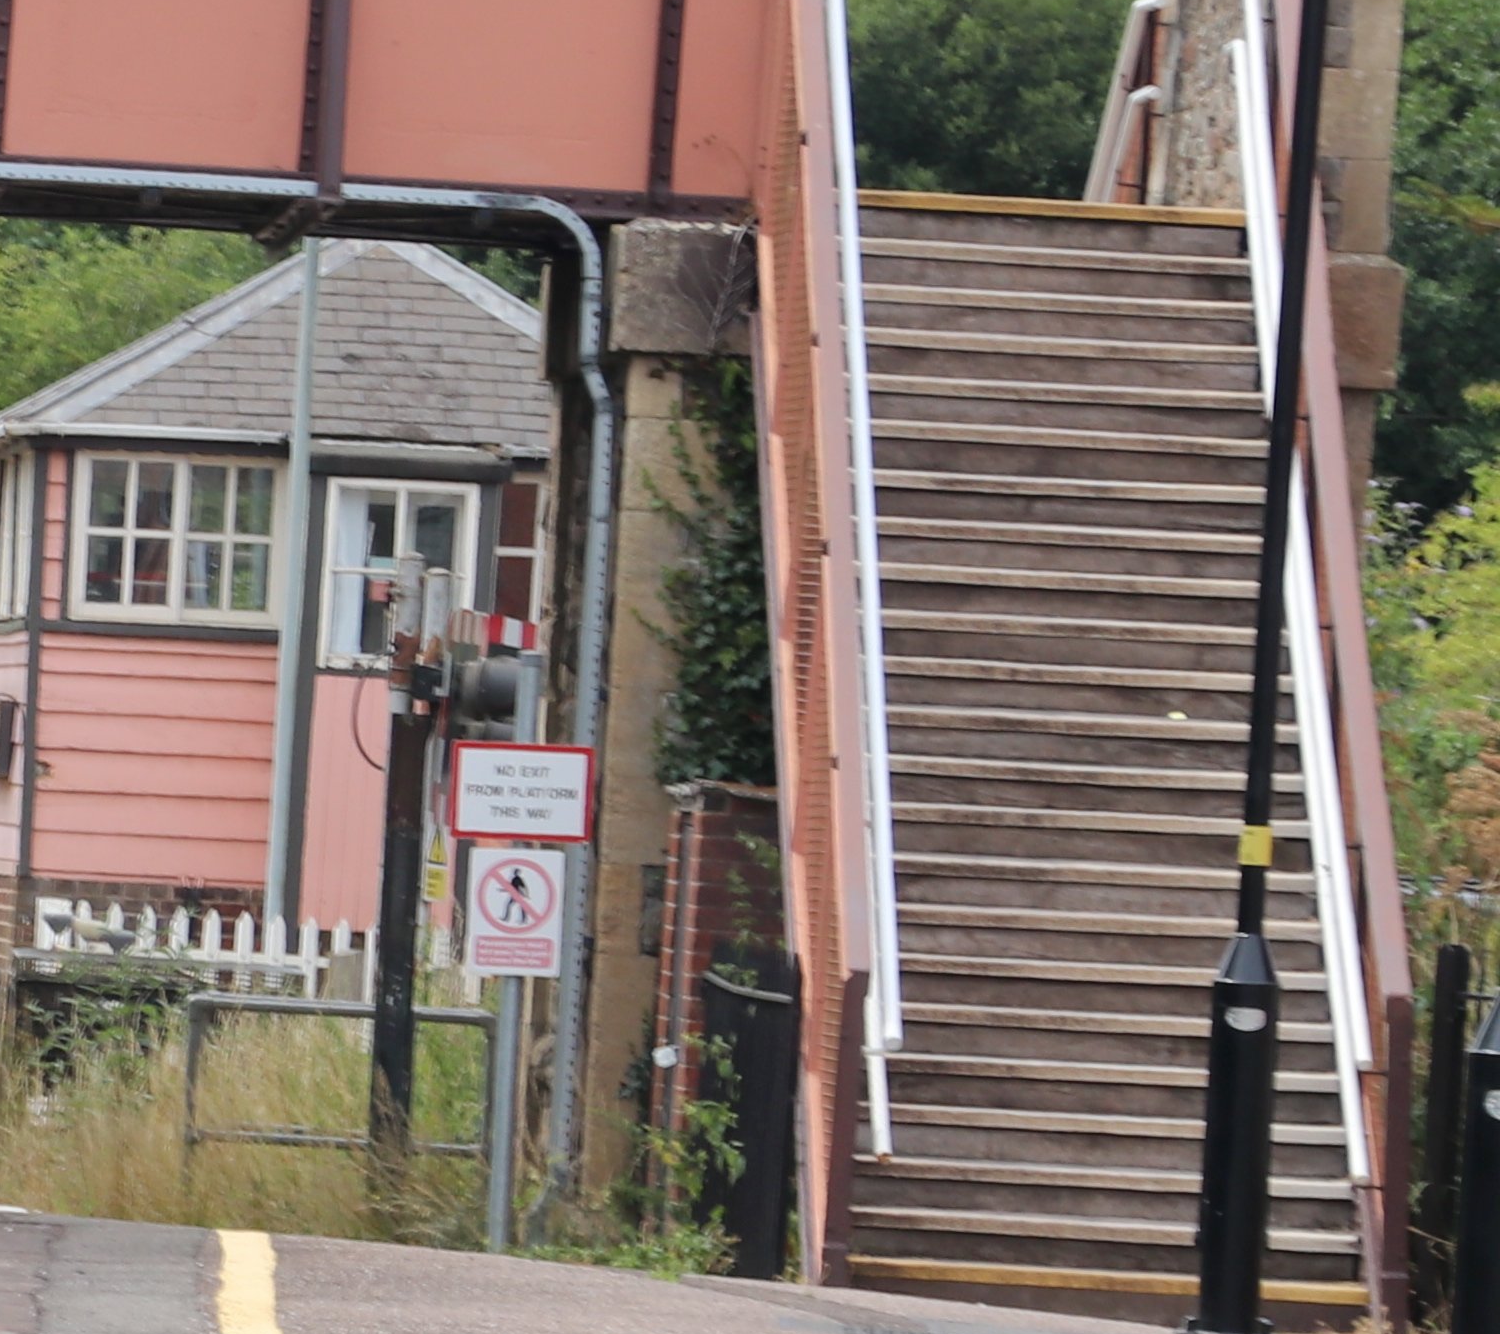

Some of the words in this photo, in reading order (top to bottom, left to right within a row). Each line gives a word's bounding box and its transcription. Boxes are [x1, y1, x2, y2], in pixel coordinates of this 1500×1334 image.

[495, 764, 516, 778] NO
[467, 783, 505, 798] FROM
[508, 785, 578, 801] PLATFORM
[489, 805, 520, 818] THIS
